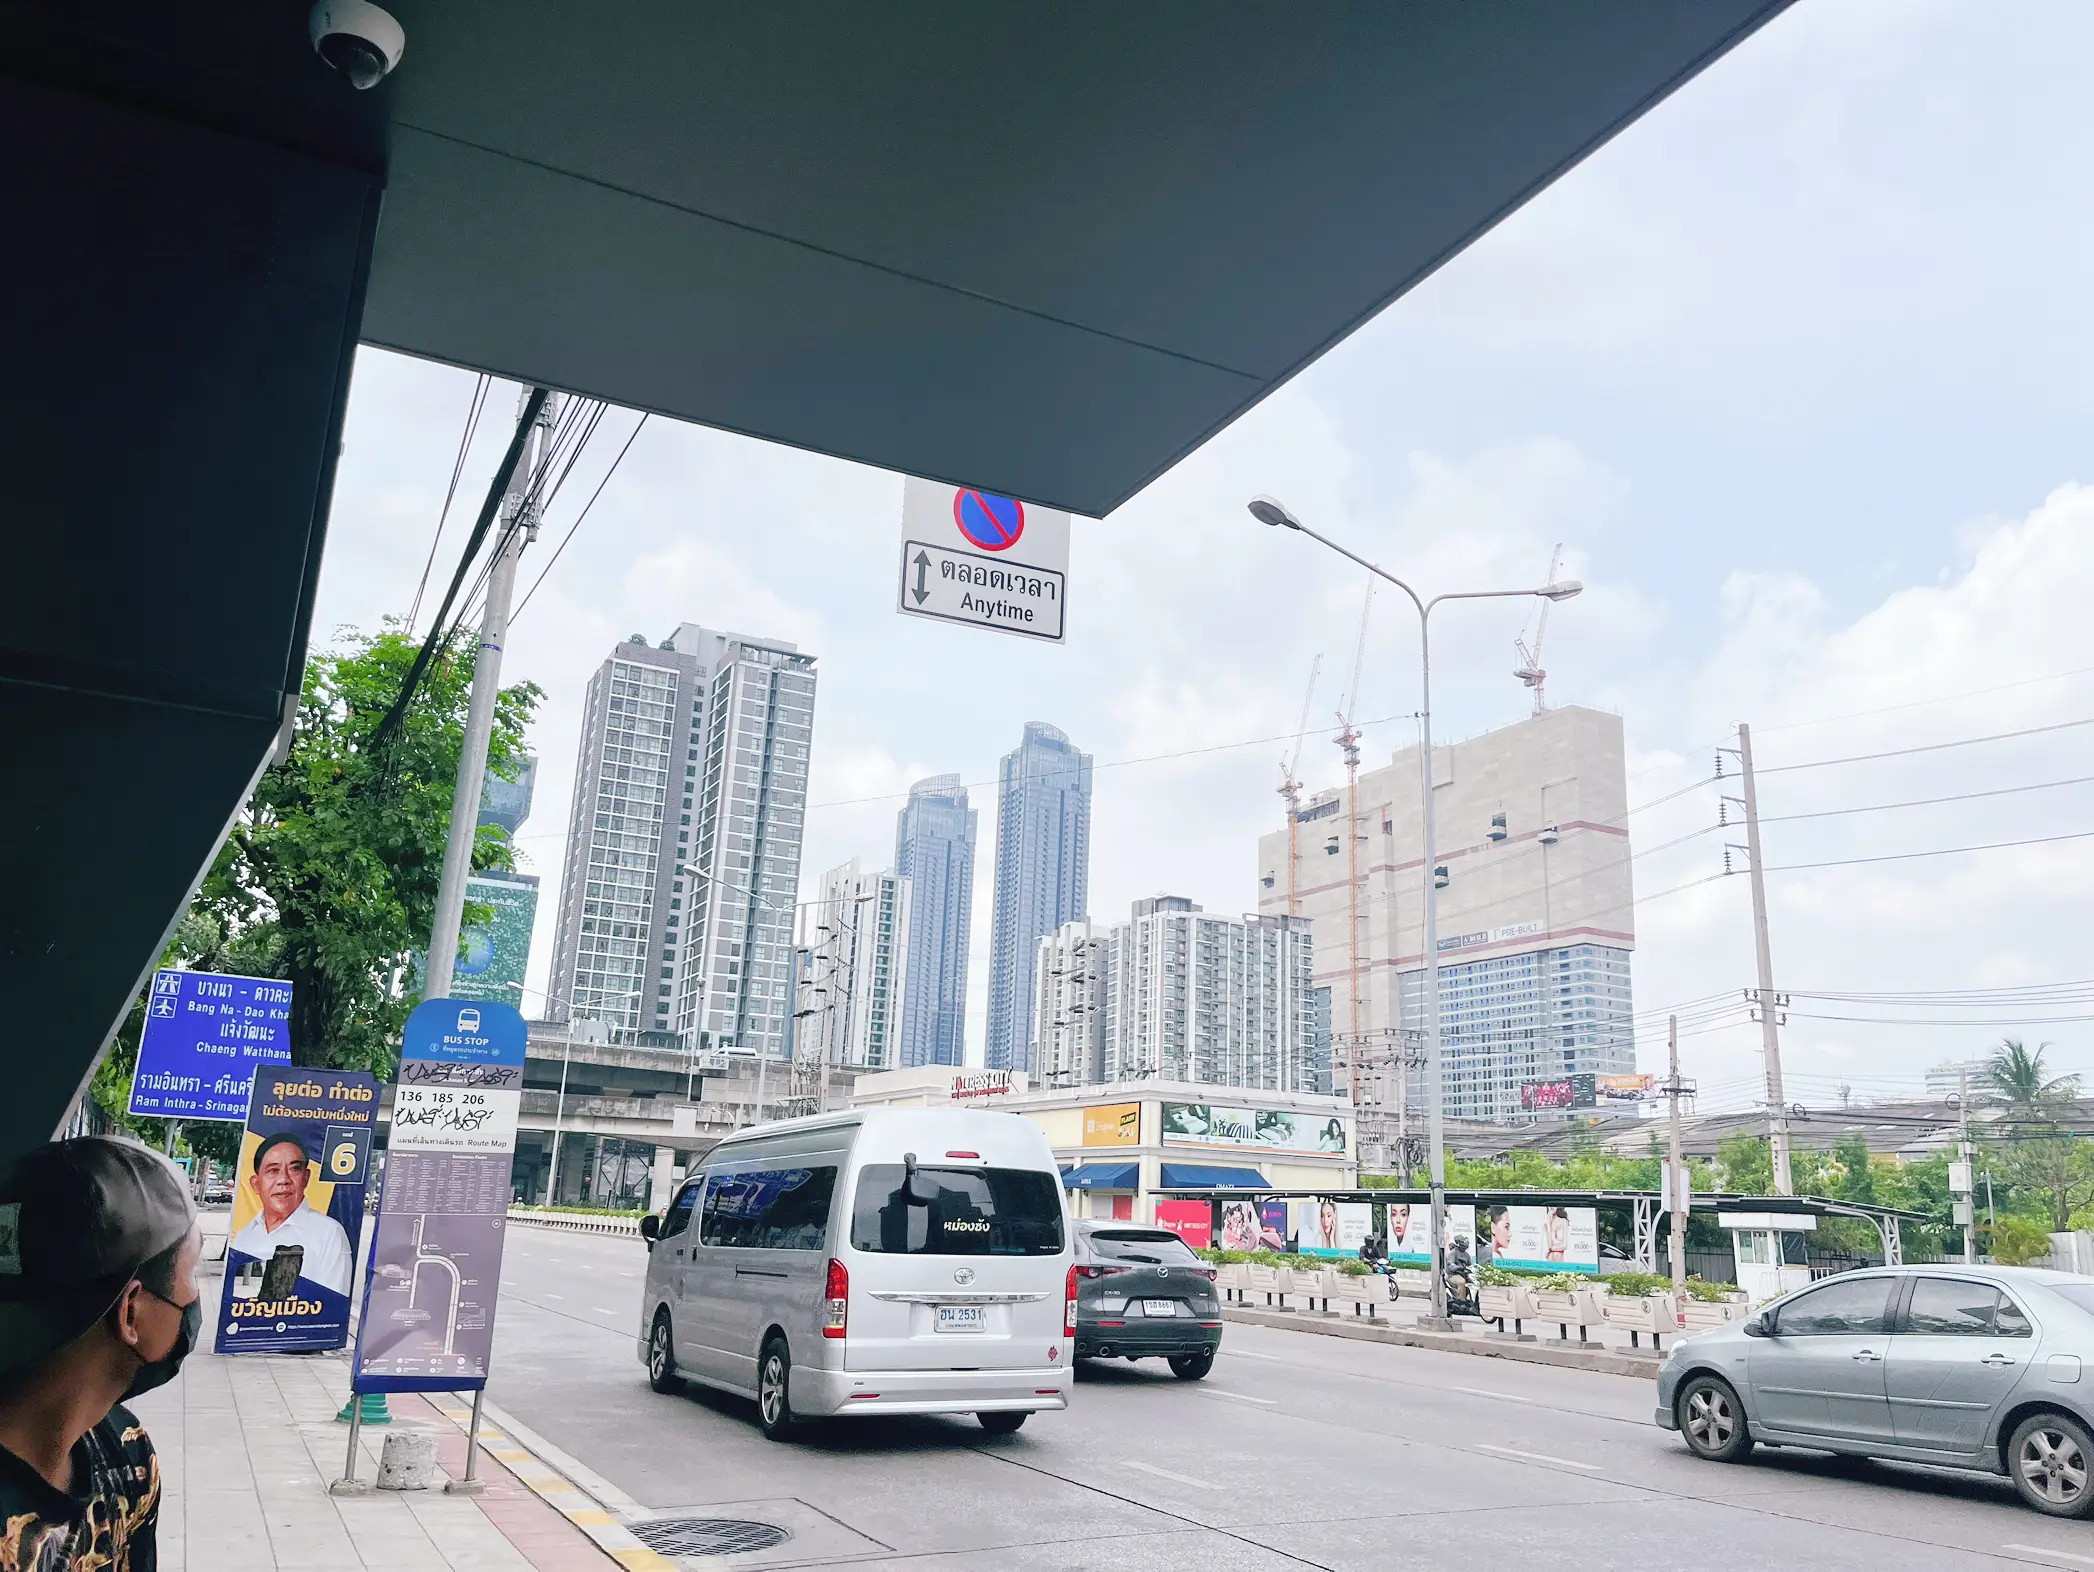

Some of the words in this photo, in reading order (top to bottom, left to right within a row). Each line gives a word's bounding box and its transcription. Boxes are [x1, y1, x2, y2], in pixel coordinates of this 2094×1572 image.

[940, 560, 1056, 600] ตลอดเวลา
[960, 592, 1034, 622] Anytime
[197, 981, 233, 998] บางนา
[187, 1000, 215, 1015] Bang
[220, 1004, 234, 1015] Na
[244, 1006, 265, 1018] Dao
[219, 1018, 276, 1041] แจ้งวัฒนะ
[443, 1035, 463, 1044] BUS
[464, 1036, 489, 1046] STOP
[196, 1041, 237, 1058] Chaeng
[243, 1045, 292, 1060] Watthana
[140, 1071, 201, 1093] รามอินทรา
[272, 1080, 323, 1101] ลุยต่อ
[328, 1081, 373, 1102] ทำต่อ
[135, 1095, 159, 1107] Ram
[164, 1097, 196, 1110] Inthra
[400, 1091, 422, 1102] 136
[432, 1092, 453, 1103] 185
[462, 1094, 485, 1105] 206
[262, 1104, 370, 1122] ไม่ต้องรอนับหนึ่งใหม่
[467, 1139, 489, 1147] Route
[490, 1139, 507, 1149] Map
[331, 1142, 357, 1176] 6
[231, 1295, 323, 1318] ขวัญเมือง
[958, 1309, 982, 1321] 2531
